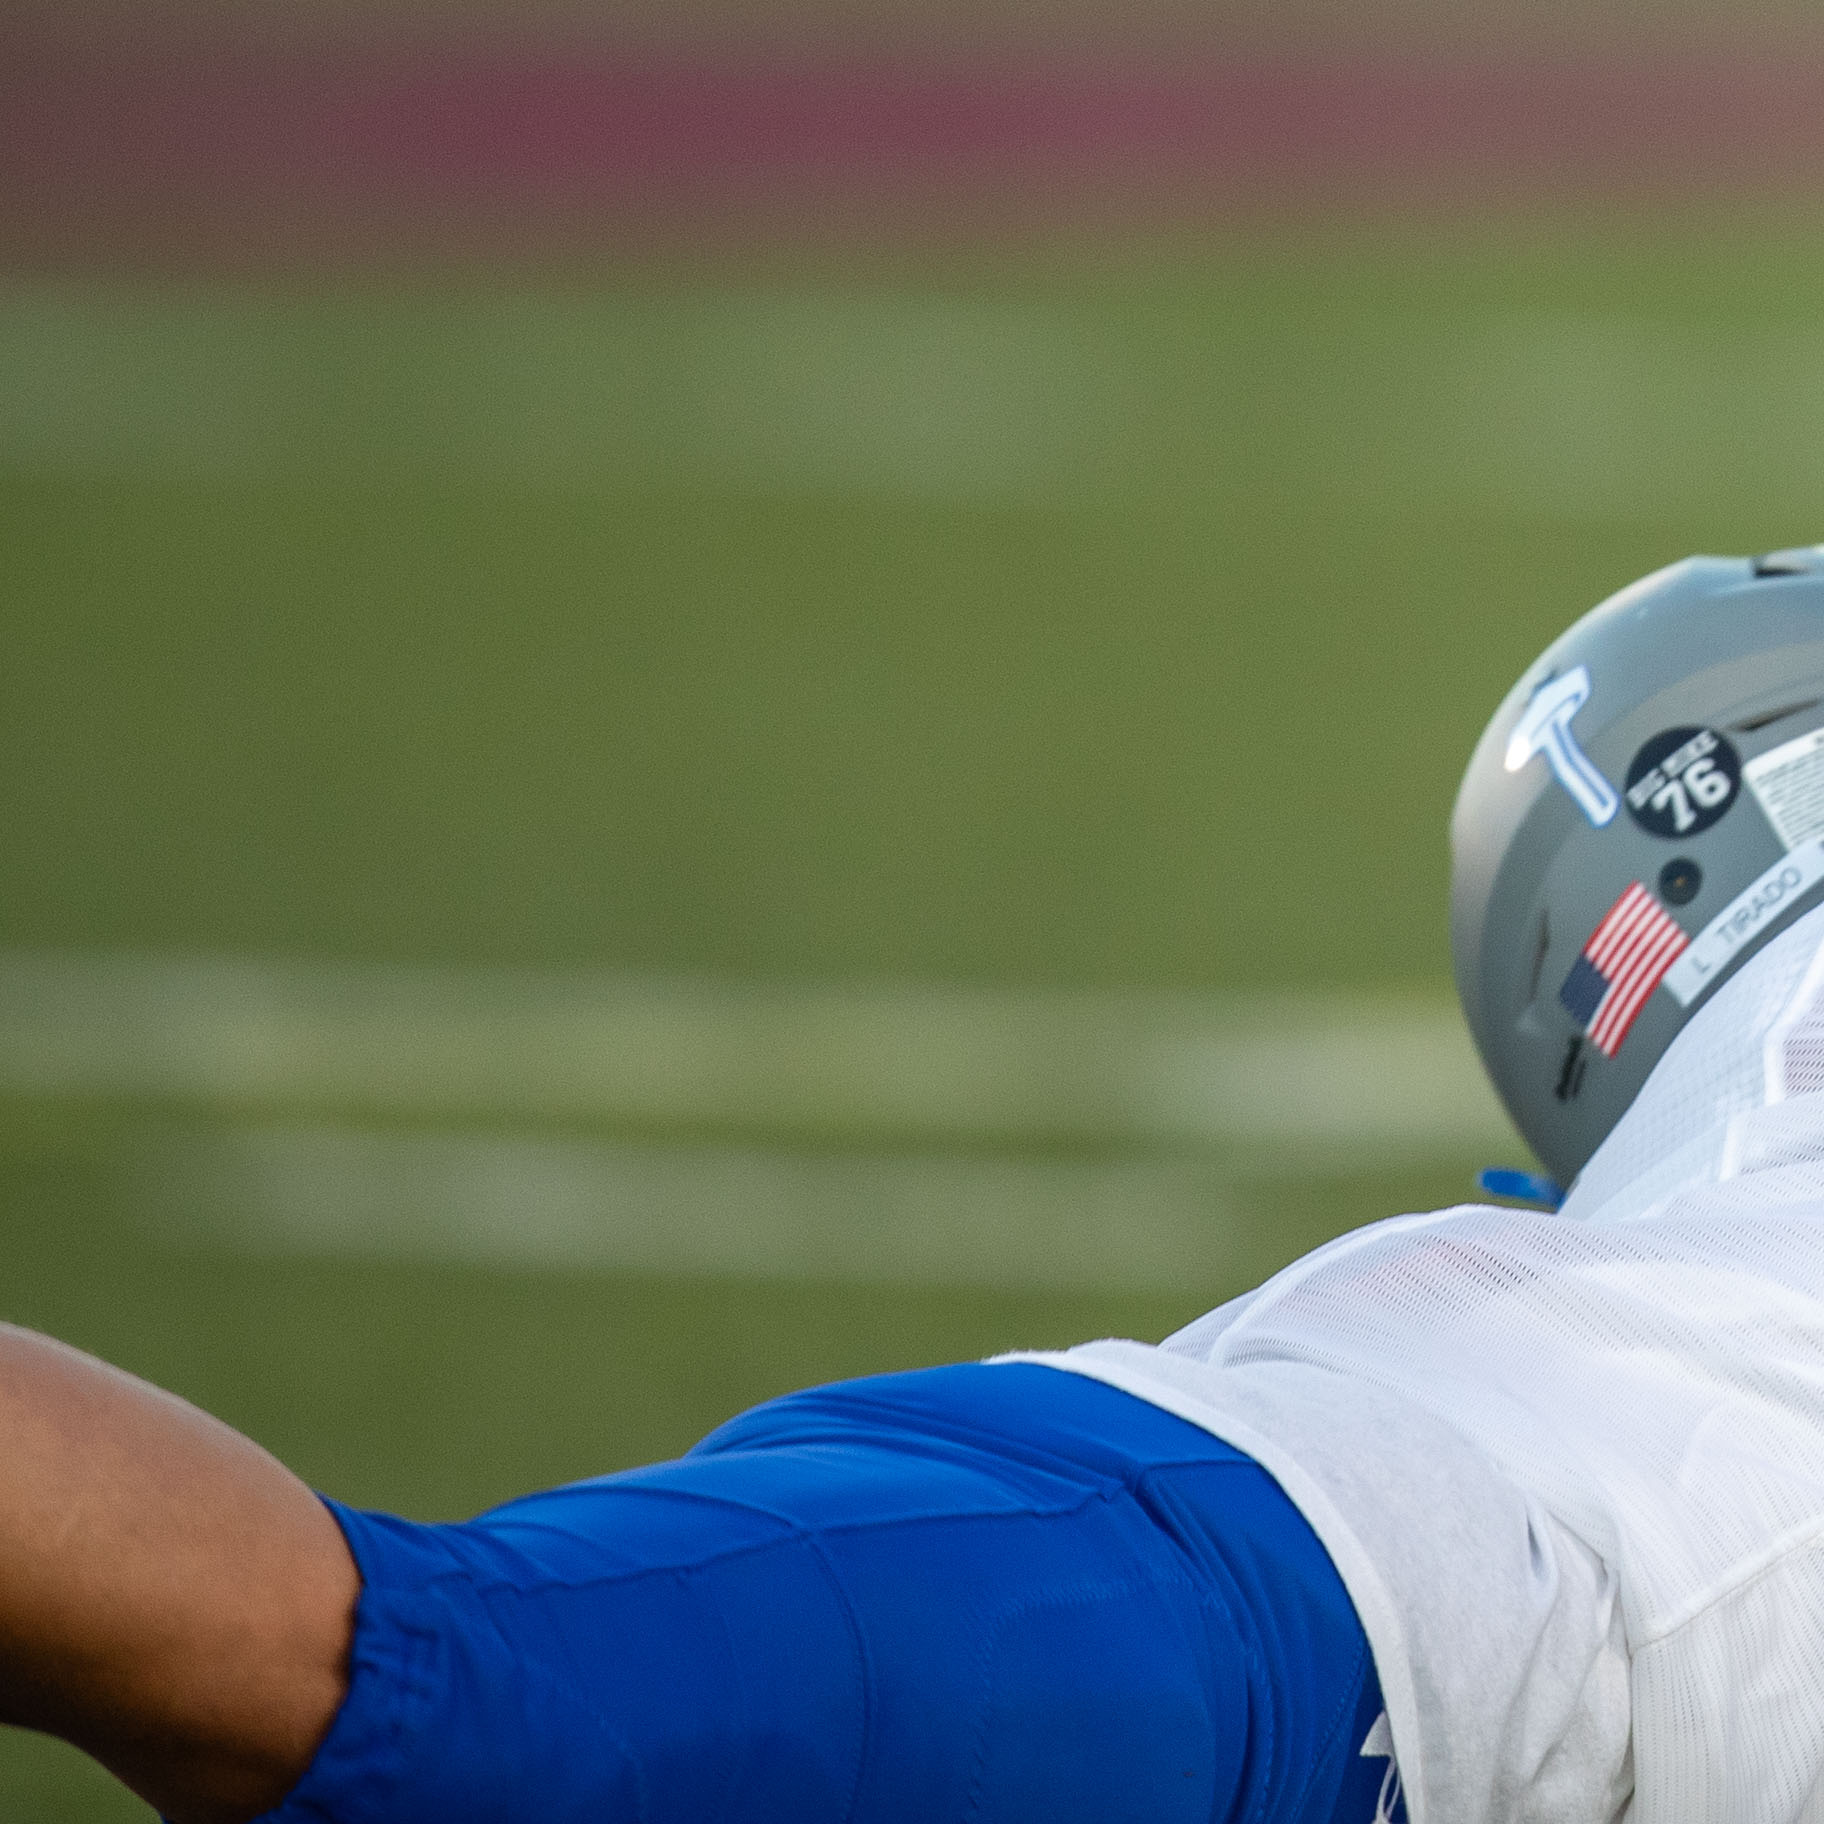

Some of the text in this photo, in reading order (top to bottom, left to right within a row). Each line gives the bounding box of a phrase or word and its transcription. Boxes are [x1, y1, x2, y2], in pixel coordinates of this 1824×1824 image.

[1505, 665, 1620, 829] T
[1651, 757, 1731, 832] 76
[1717, 866, 1802, 943] TIRADO
